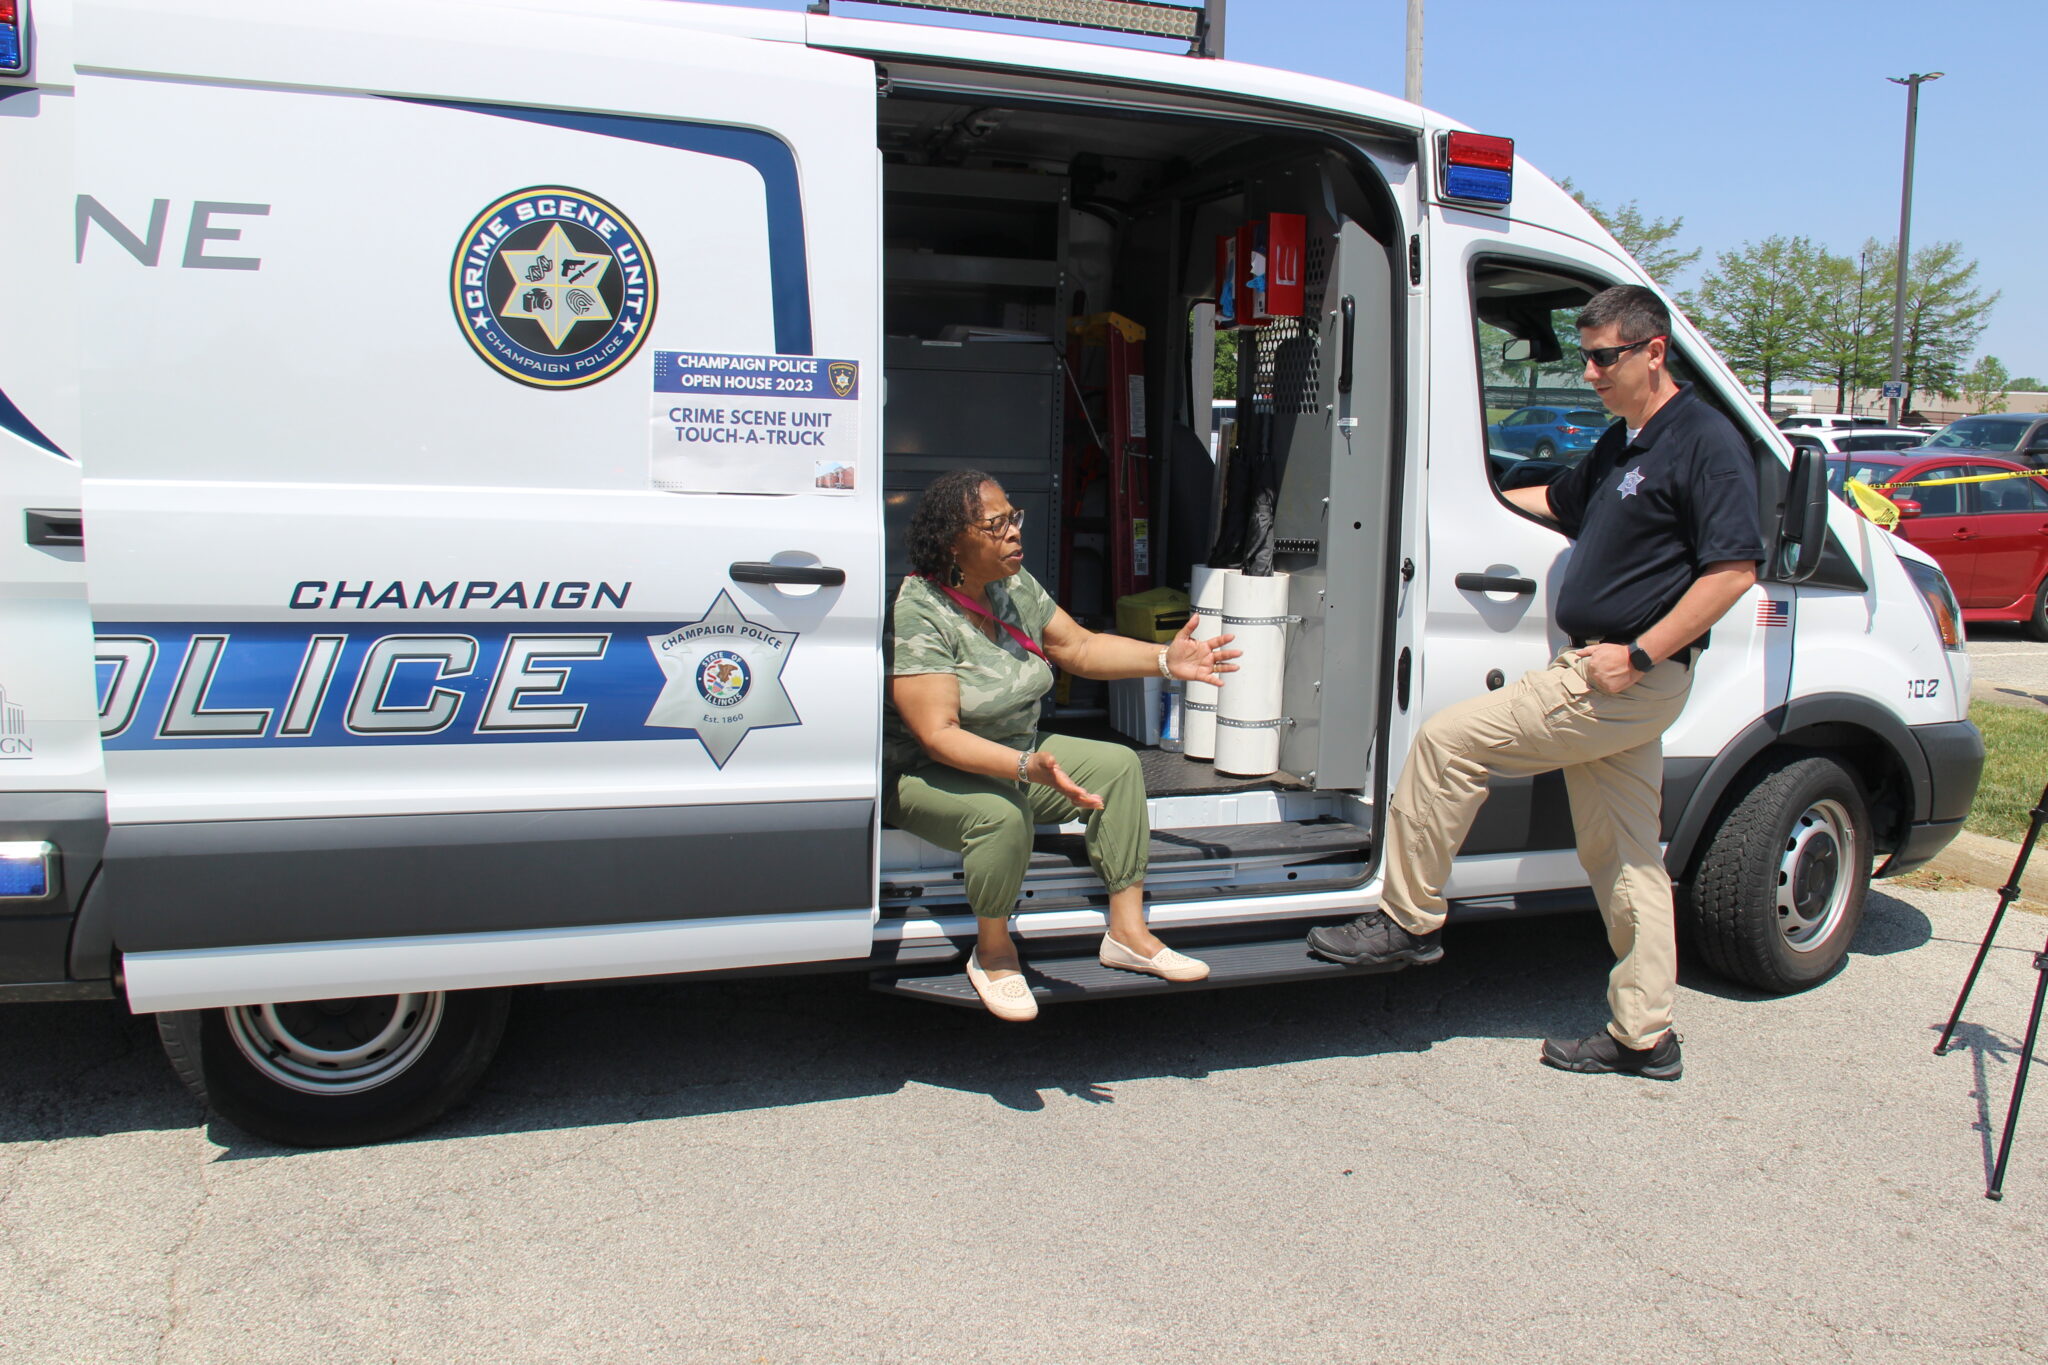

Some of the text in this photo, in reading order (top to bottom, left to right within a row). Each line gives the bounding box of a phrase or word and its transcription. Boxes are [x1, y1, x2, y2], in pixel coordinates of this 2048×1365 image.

[75, 194, 271, 271] NE
[465, 199, 644, 315] CRIME SCENE UNIT
[485, 331, 623, 373] CHAMPAIGN POLICE
[677, 355, 818, 374] CHAMPAIGN POLICE
[681, 374, 813, 391] OPEN HOUSE 2023
[669, 407, 832, 427] CRIME SCENE UNIT
[675, 427, 825, 446] TOUCH-A-TRUCK
[289, 580, 632, 609] CHAMPAIGN
[661, 625, 783, 651] CHAMPAIGN POLICE
[702, 651, 742, 667] STATE OF
[1907, 678, 1939, 699] 102
[704, 692, 743, 706] ILLINOIS
[703, 713, 744, 724] Est. 1860
